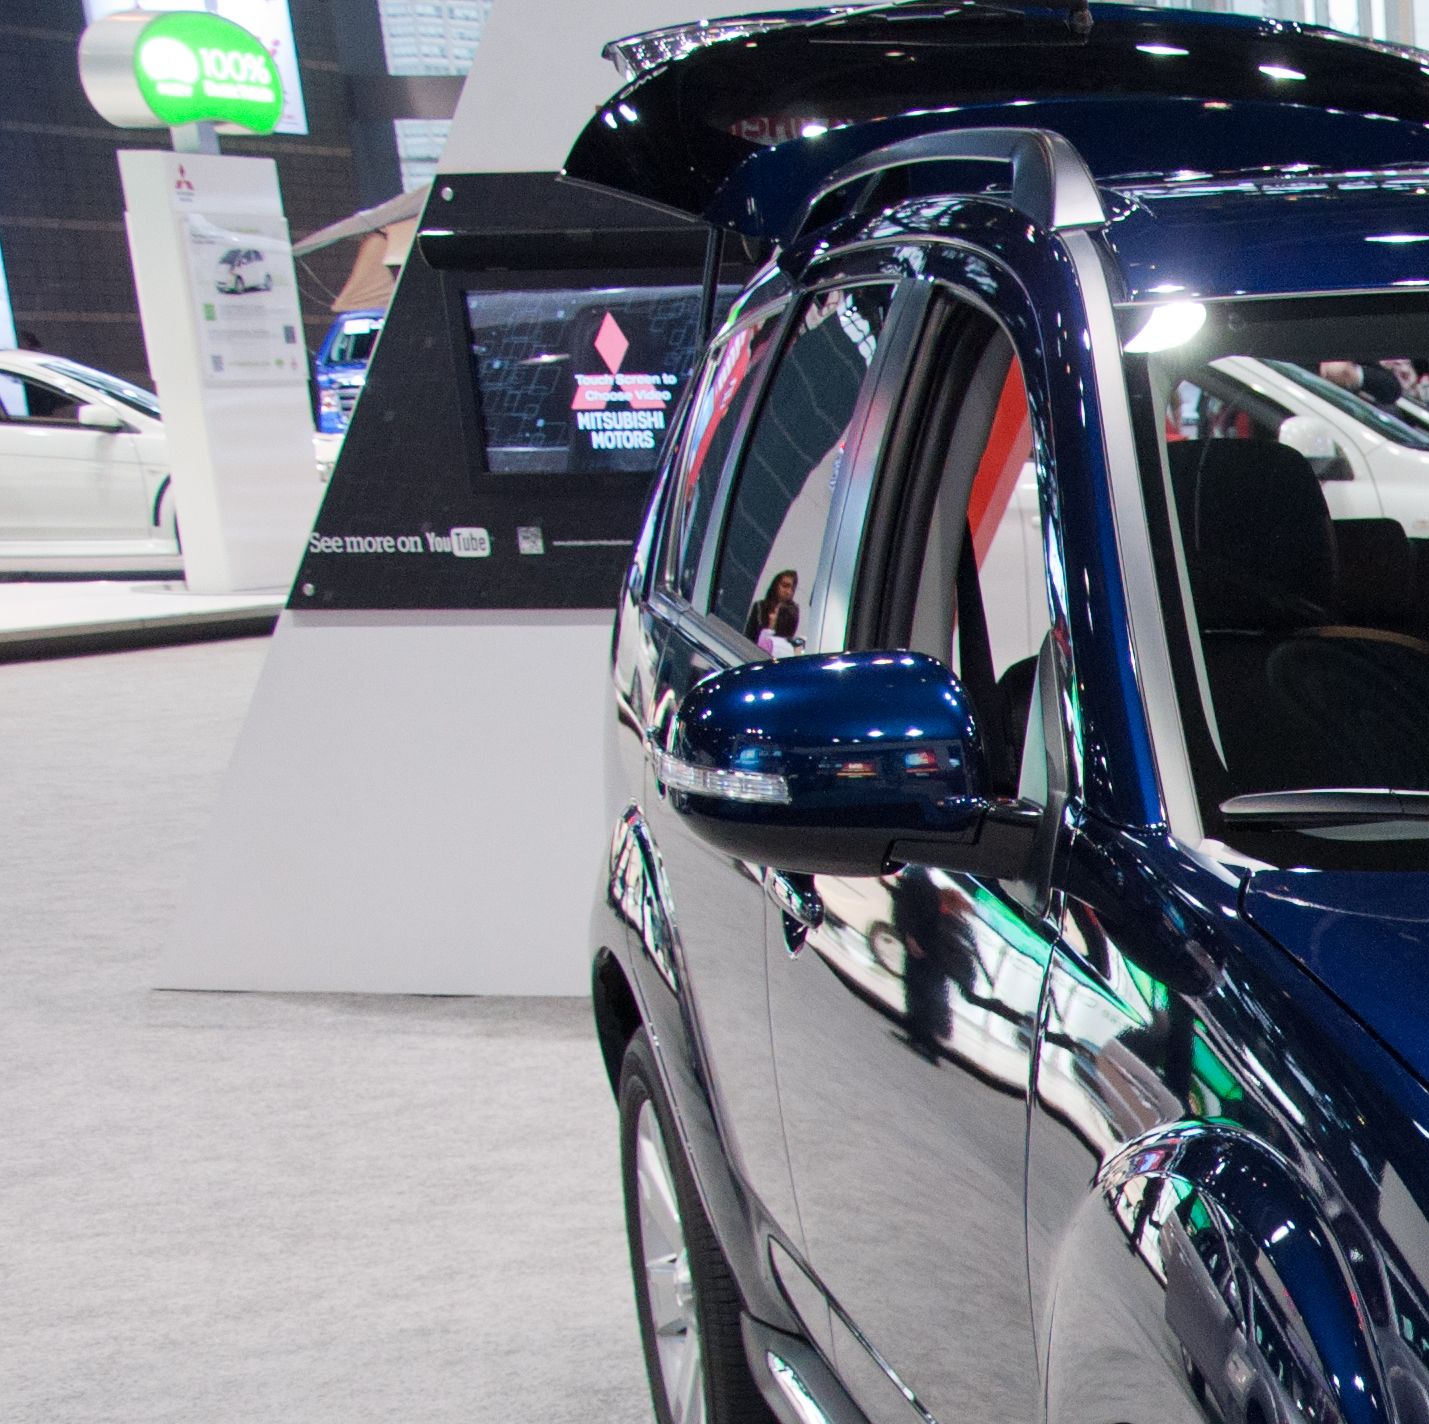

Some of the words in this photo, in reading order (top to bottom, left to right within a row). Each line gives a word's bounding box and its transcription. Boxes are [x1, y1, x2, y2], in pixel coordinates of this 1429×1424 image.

[200, 48, 271, 84] 100%
[574, 373, 614, 386] Touch
[615, 373, 661, 386] Screen
[662, 372, 678, 386] to
[585, 390, 633, 402] Choose
[635, 389, 672, 401] Video
[576, 411, 666, 430] MITSUBISHI
[590, 430, 656, 449] MOTORS
[309, 531, 344, 553] See
[344, 535, 396, 553] more
[397, 535, 424, 553] on
